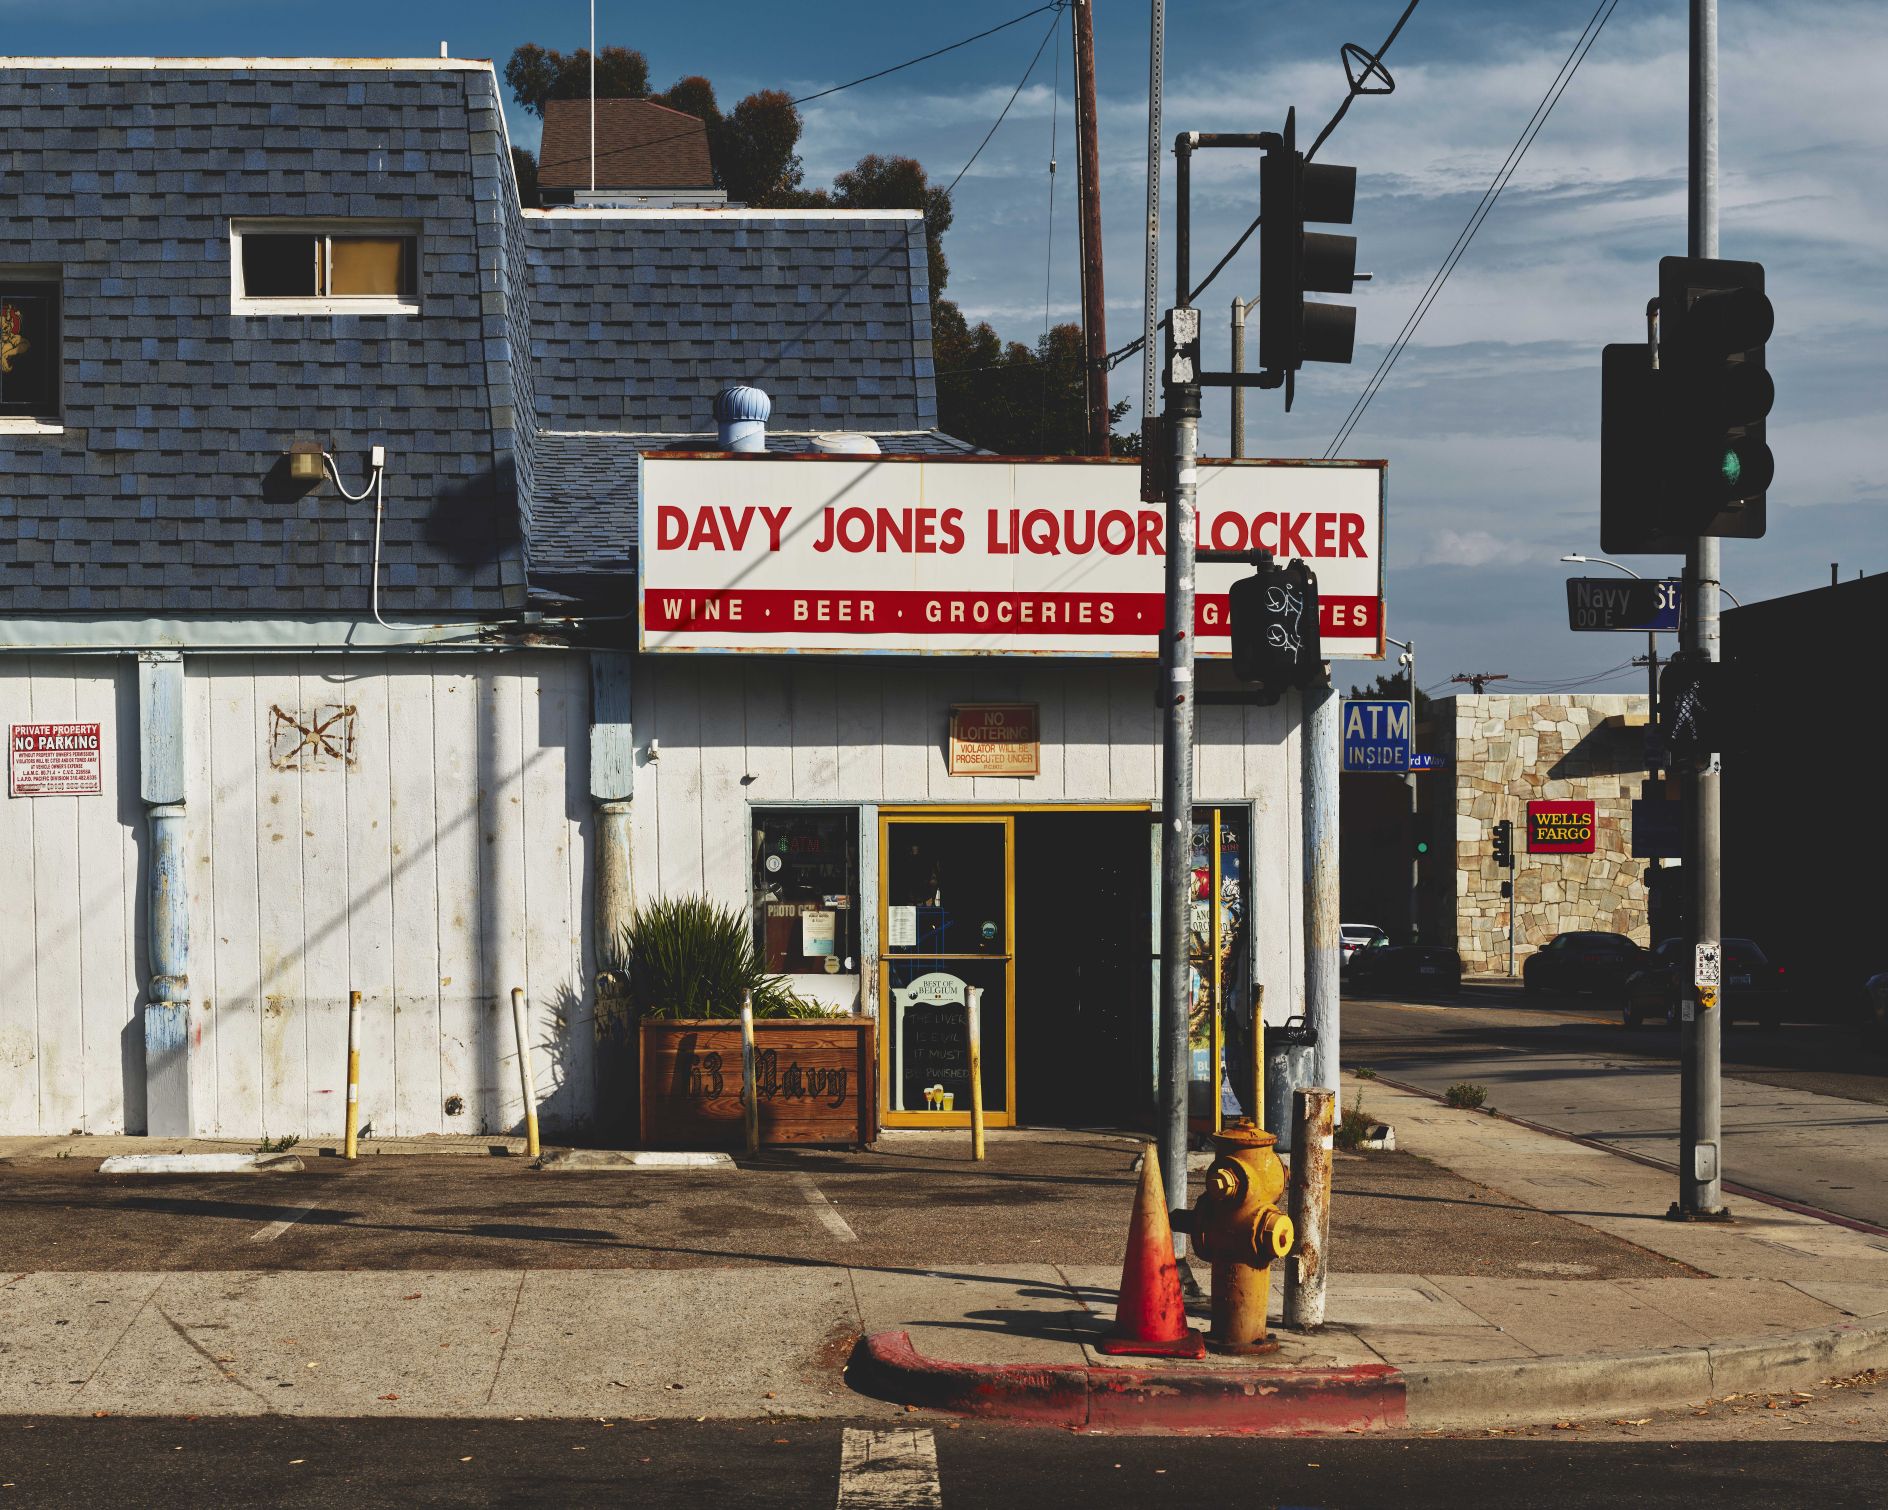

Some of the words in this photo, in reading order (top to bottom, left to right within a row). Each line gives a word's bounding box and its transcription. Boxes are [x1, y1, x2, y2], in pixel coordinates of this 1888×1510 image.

[658, 505, 792, 552] DAVY
[812, 507, 965, 555] JONES
[987, 508, 1167, 556] LIQUOR
[1195, 511, 1368, 559] LOCKER
[1577, 583, 1631, 615] Navy
[1653, 583, 1676, 610] St
[663, 598, 742, 620] WINE
[793, 600, 875, 622] BEER
[925, 600, 1115, 624] GROCERIES
[1604, 609, 1614, 627] E
[984, 711, 1004, 726] NO
[1345, 705, 1409, 740] ATM
[15, 726, 50, 735] PRIVATE
[52, 725, 98, 735] PROPERTY
[960, 726, 1029, 740] LOITERING
[15, 737, 34, 751] NO
[38, 735, 98, 750] PARKING
[960, 743, 996, 754] VIOLATOR
[999, 744, 1016, 754] WILL
[1018, 744, 1029, 753] BE
[955, 754, 1005, 764] PROSECUTED
[1007, 753, 1033, 763] UNDER
[1349, 746, 1404, 765] INSIDE
[1535, 813, 1592, 825] WELLS
[1536, 827, 1591, 840] FARGO
[767, 904, 796, 917] PHOTO
[918, 986, 958, 994] BELGIUM
[909, 1013, 930, 1025] THE
[935, 1012, 968, 1026] LIVER
[913, 1048, 924, 1059] IT
[929, 1049, 964, 1060] MUST
[925, 1067, 970, 1080] PUNISHED
